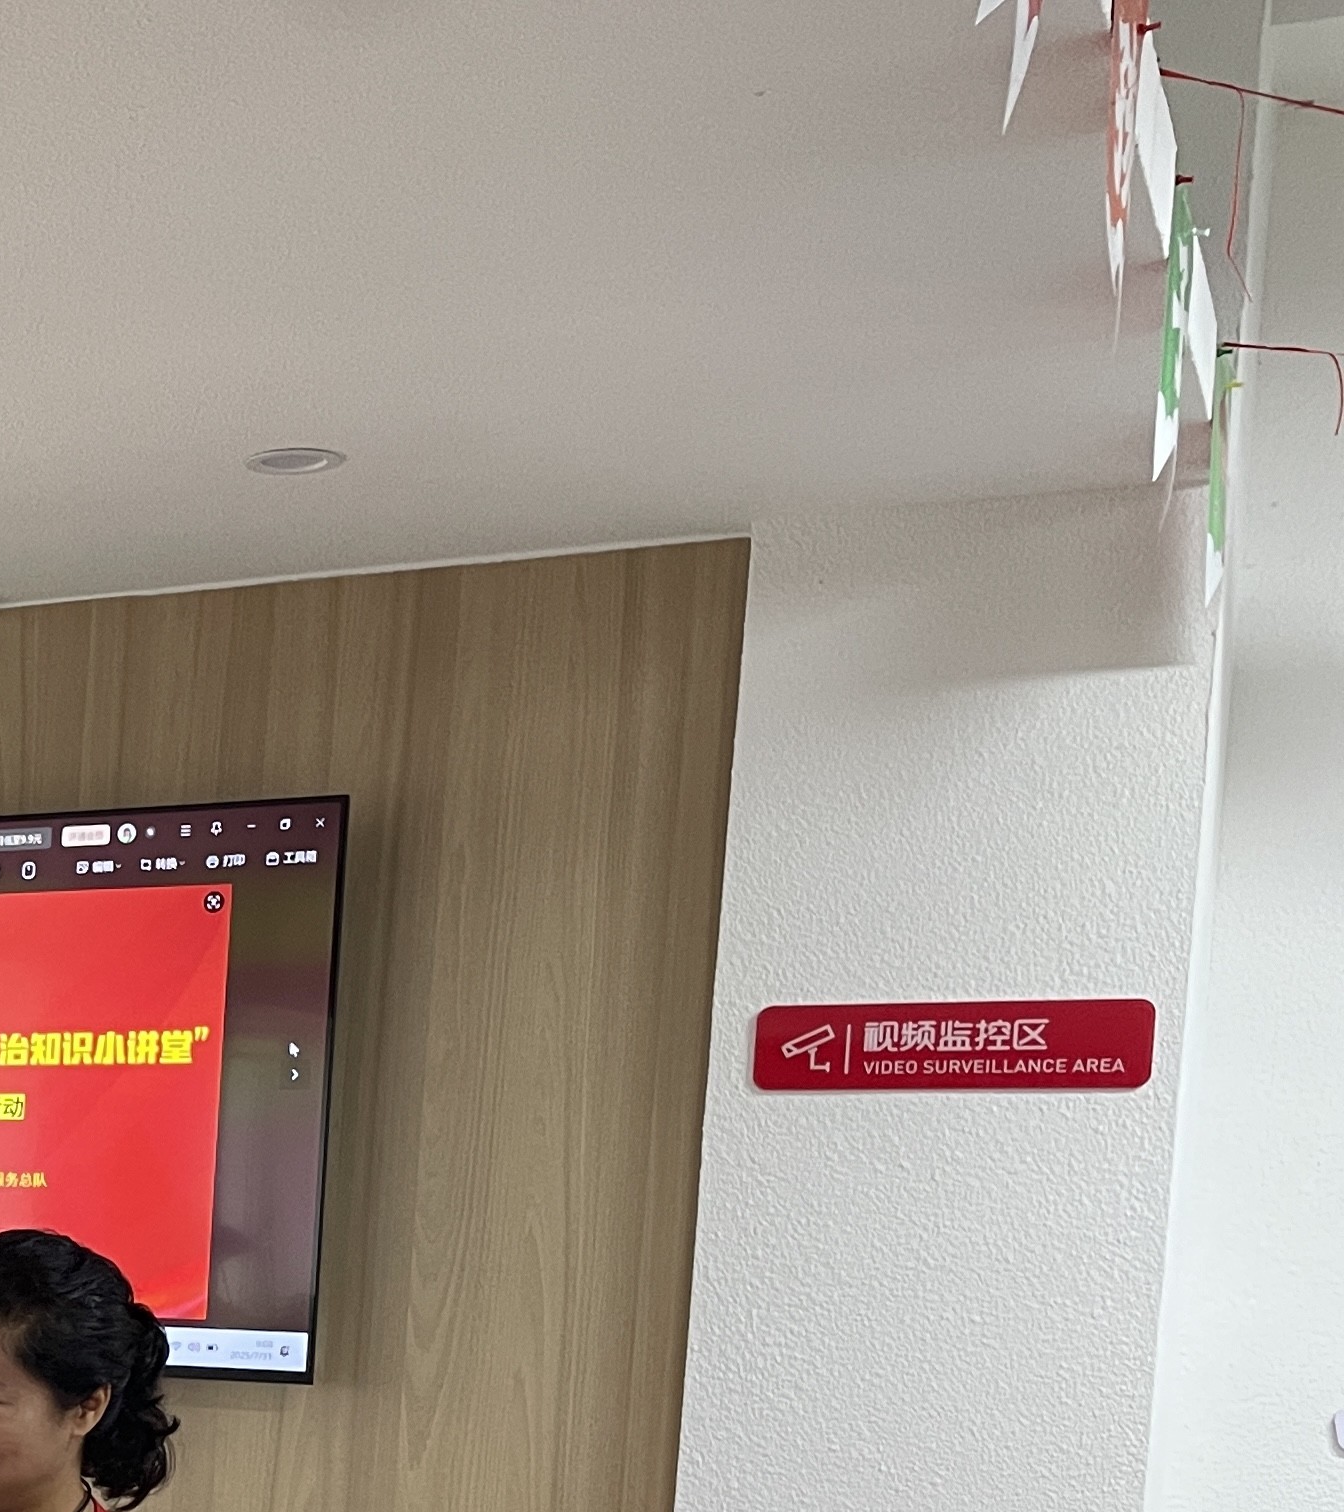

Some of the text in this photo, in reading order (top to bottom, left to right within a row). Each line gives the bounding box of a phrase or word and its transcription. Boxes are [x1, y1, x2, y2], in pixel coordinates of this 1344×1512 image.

[863, 1018, 1050, 1053] 视频监控区
[863, 1057, 1125, 1075] VIDEO SURVEILLANCE AREA
